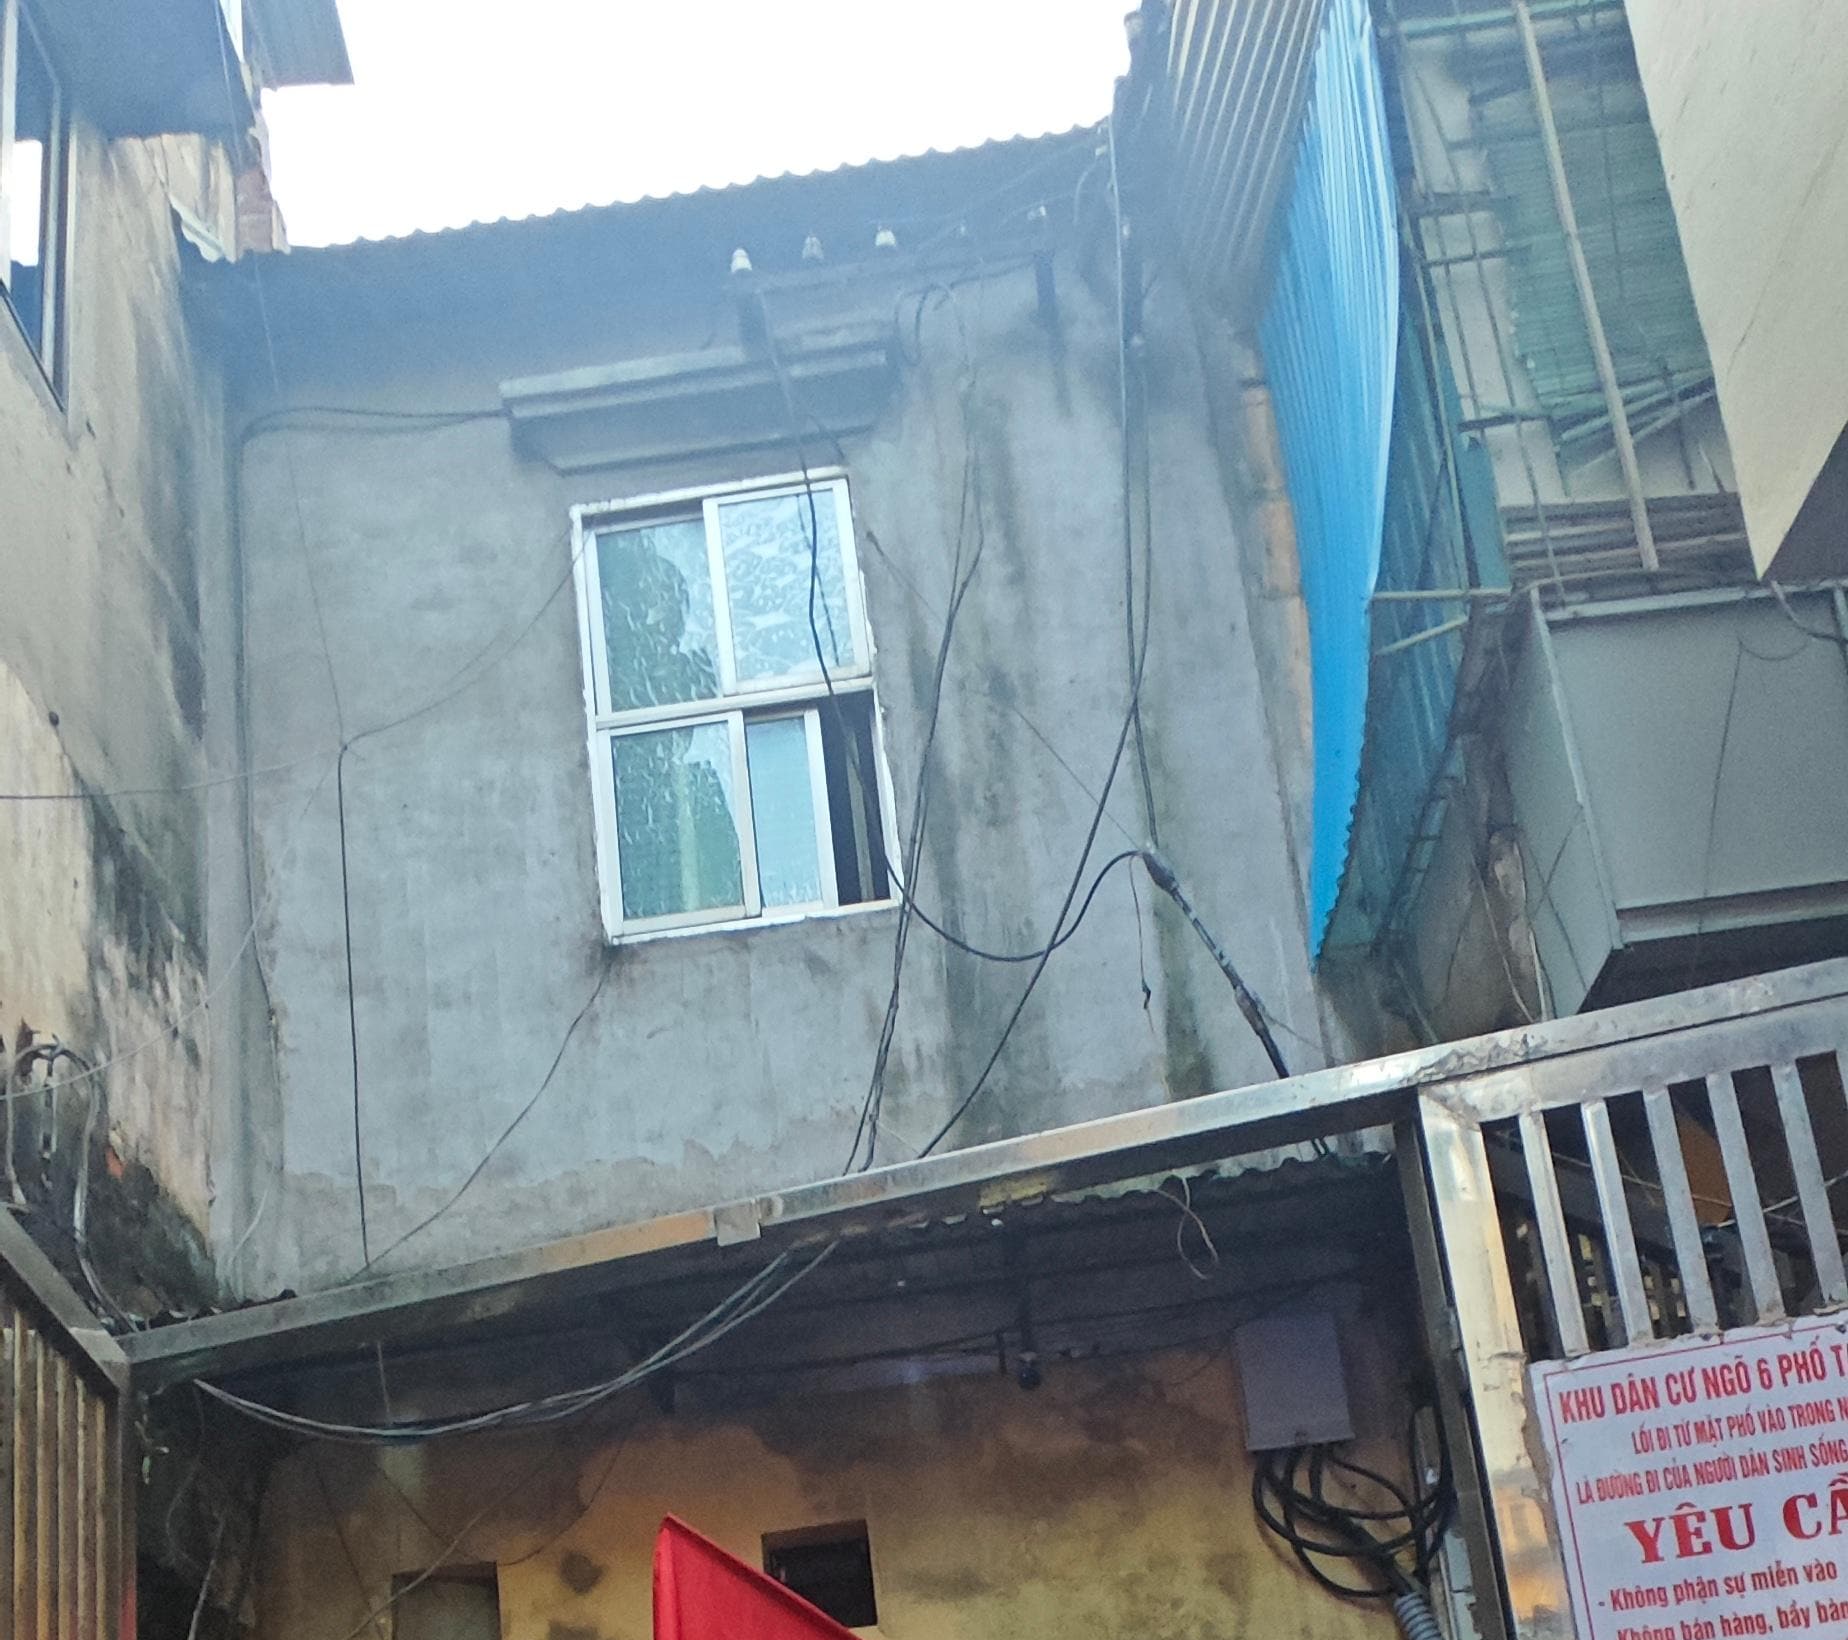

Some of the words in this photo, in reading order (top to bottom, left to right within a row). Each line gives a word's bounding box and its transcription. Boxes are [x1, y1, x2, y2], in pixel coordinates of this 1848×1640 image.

[1559, 1386, 1605, 1424] KHU
[1611, 1373, 1660, 1415] DÂN
[1665, 1366, 1697, 1405] CƯ
[1702, 1355, 1751, 1399] NGÕ
[1757, 1358, 1773, 1390] 6
[1777, 1335, 1826, 1387] PHỐ
[1830, 1344, 1848, 1377] T
[1631, 1420, 1654, 1454] LỐI
[1656, 1426, 1672, 1451] ĐI
[1726, 1404, 1756, 1438] PHỐ
[1757, 1404, 1786, 1433] VÀO
[1788, 1399, 1836, 1429] TRONG
[1576, 1475, 1595, 1504] LÀ
[1645, 1469, 1661, 1493] ĐI
[1663, 1457, 1692, 1490] CỦA
[1693, 1452, 1737, 1485] NGƯỜI
[1739, 1448, 1770, 1478] DÂN
[1772, 1445, 1808, 1473] SINH
[1624, 1502, 1757, 1564] YÊU
[1610, 1585, 1668, 1612] Không
[1723, 1572, 1746, 1598] sự
[1802, 1558, 1838, 1582] vào
